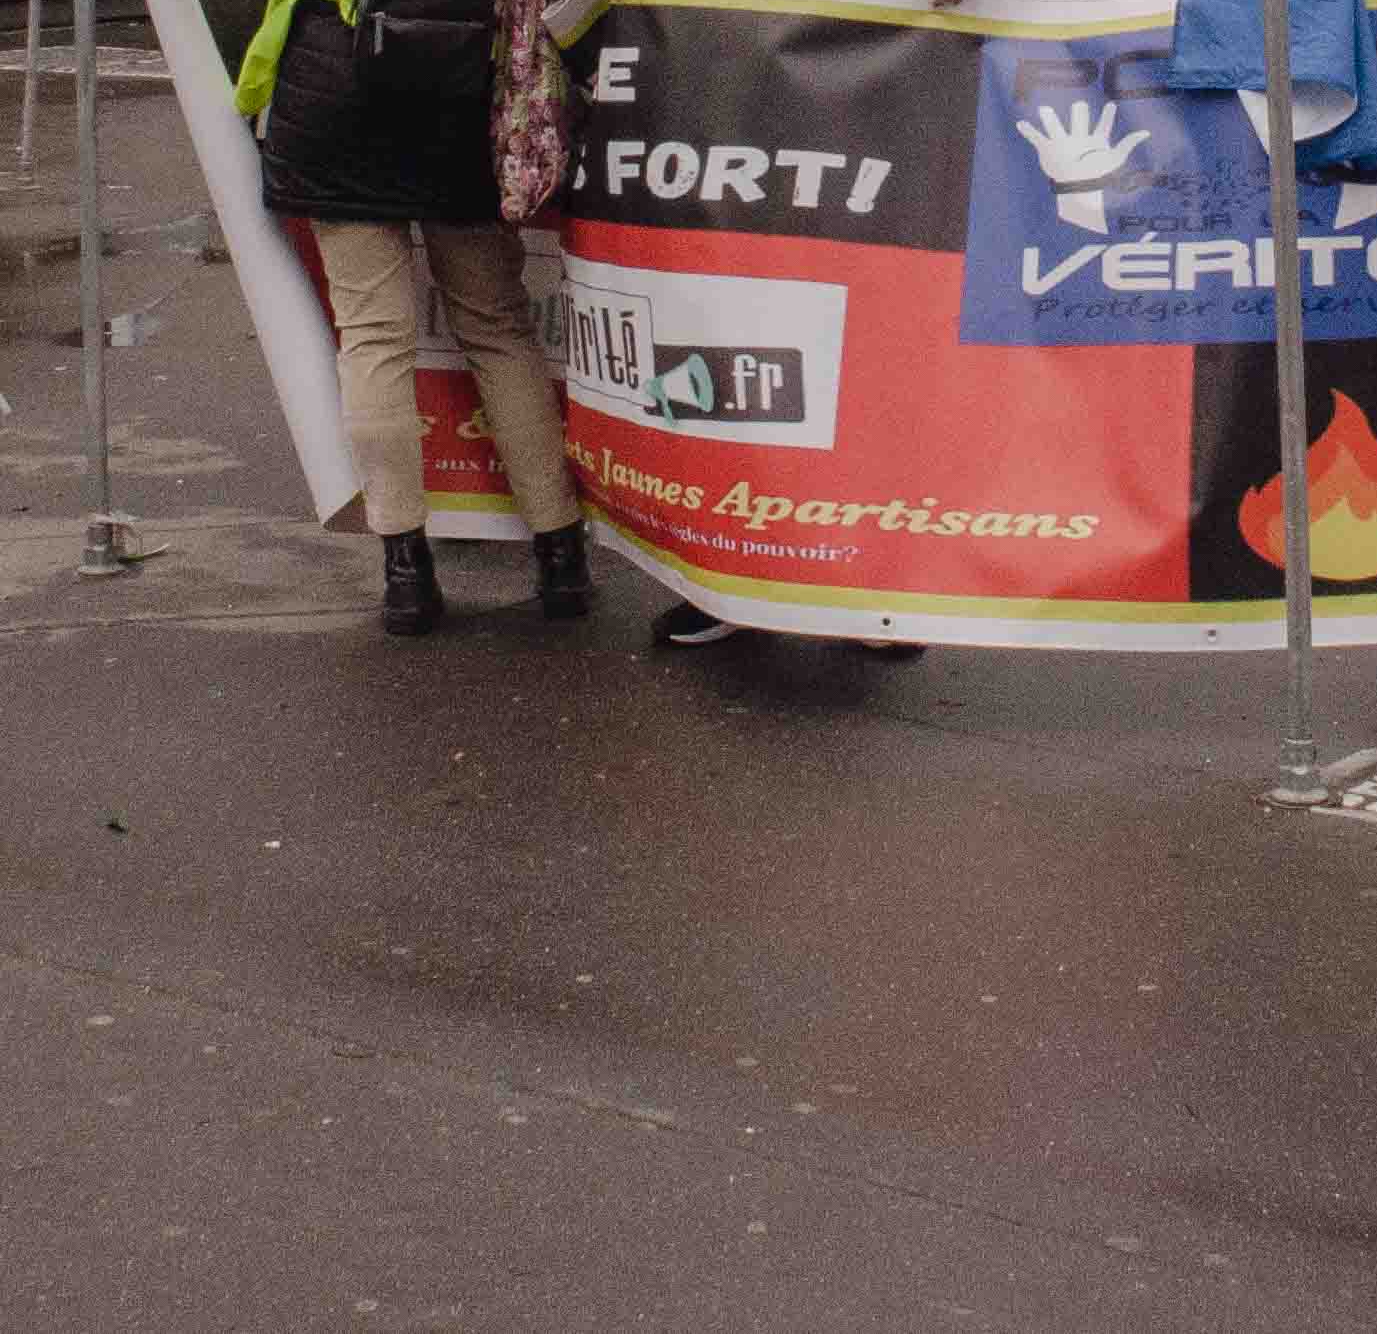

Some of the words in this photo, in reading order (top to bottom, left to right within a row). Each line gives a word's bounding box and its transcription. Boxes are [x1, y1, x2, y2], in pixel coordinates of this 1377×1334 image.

[606, 140, 892, 213] FORT!
[725, 353, 785, 411] .fr
[599, 448, 705, 511] Jaunes
[711, 481, 1100, 539] Apartisans
[711, 533, 737, 551] du
[742, 536, 859, 563] pouvoir?
